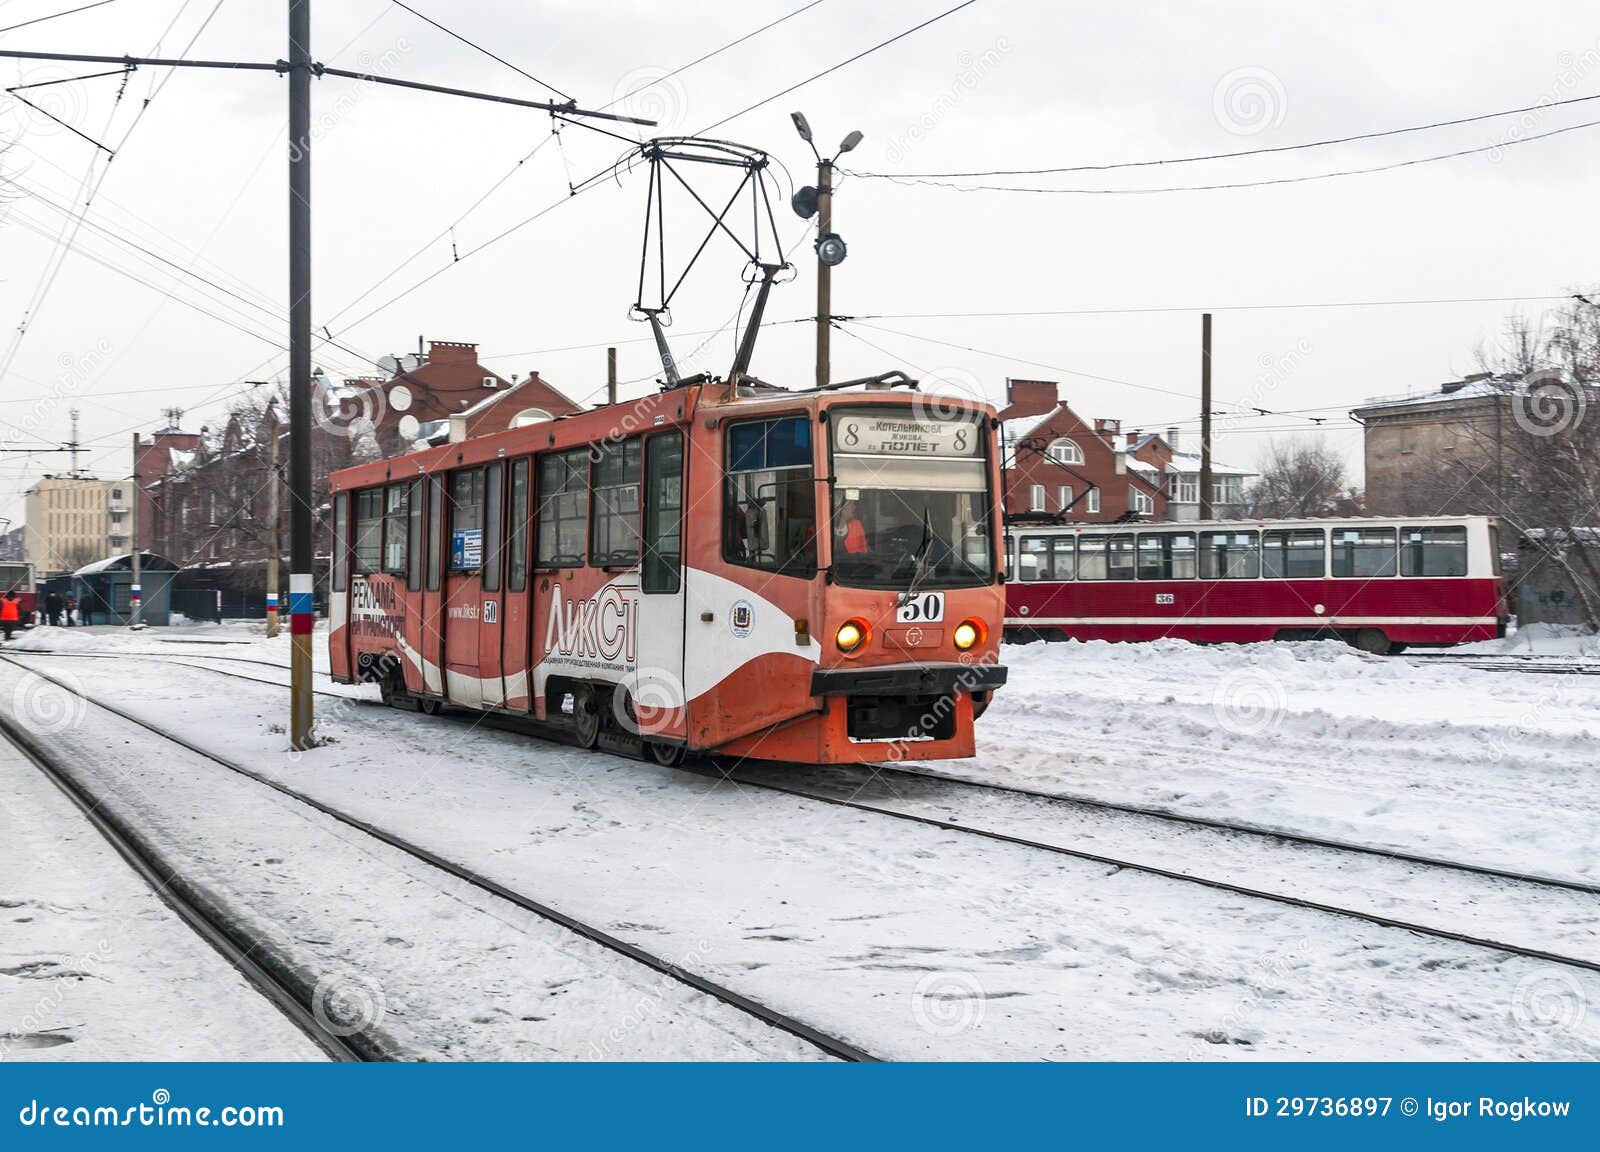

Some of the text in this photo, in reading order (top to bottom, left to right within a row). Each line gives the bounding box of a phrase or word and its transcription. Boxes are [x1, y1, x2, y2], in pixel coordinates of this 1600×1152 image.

[845, 423, 860, 446] 8
[953, 429, 967, 451] 8
[352, 581, 396, 609] РЕКЛАМА
[1157, 595, 1173, 603] 36
[485, 601, 496, 622] 50
[903, 594, 940, 621] 50
